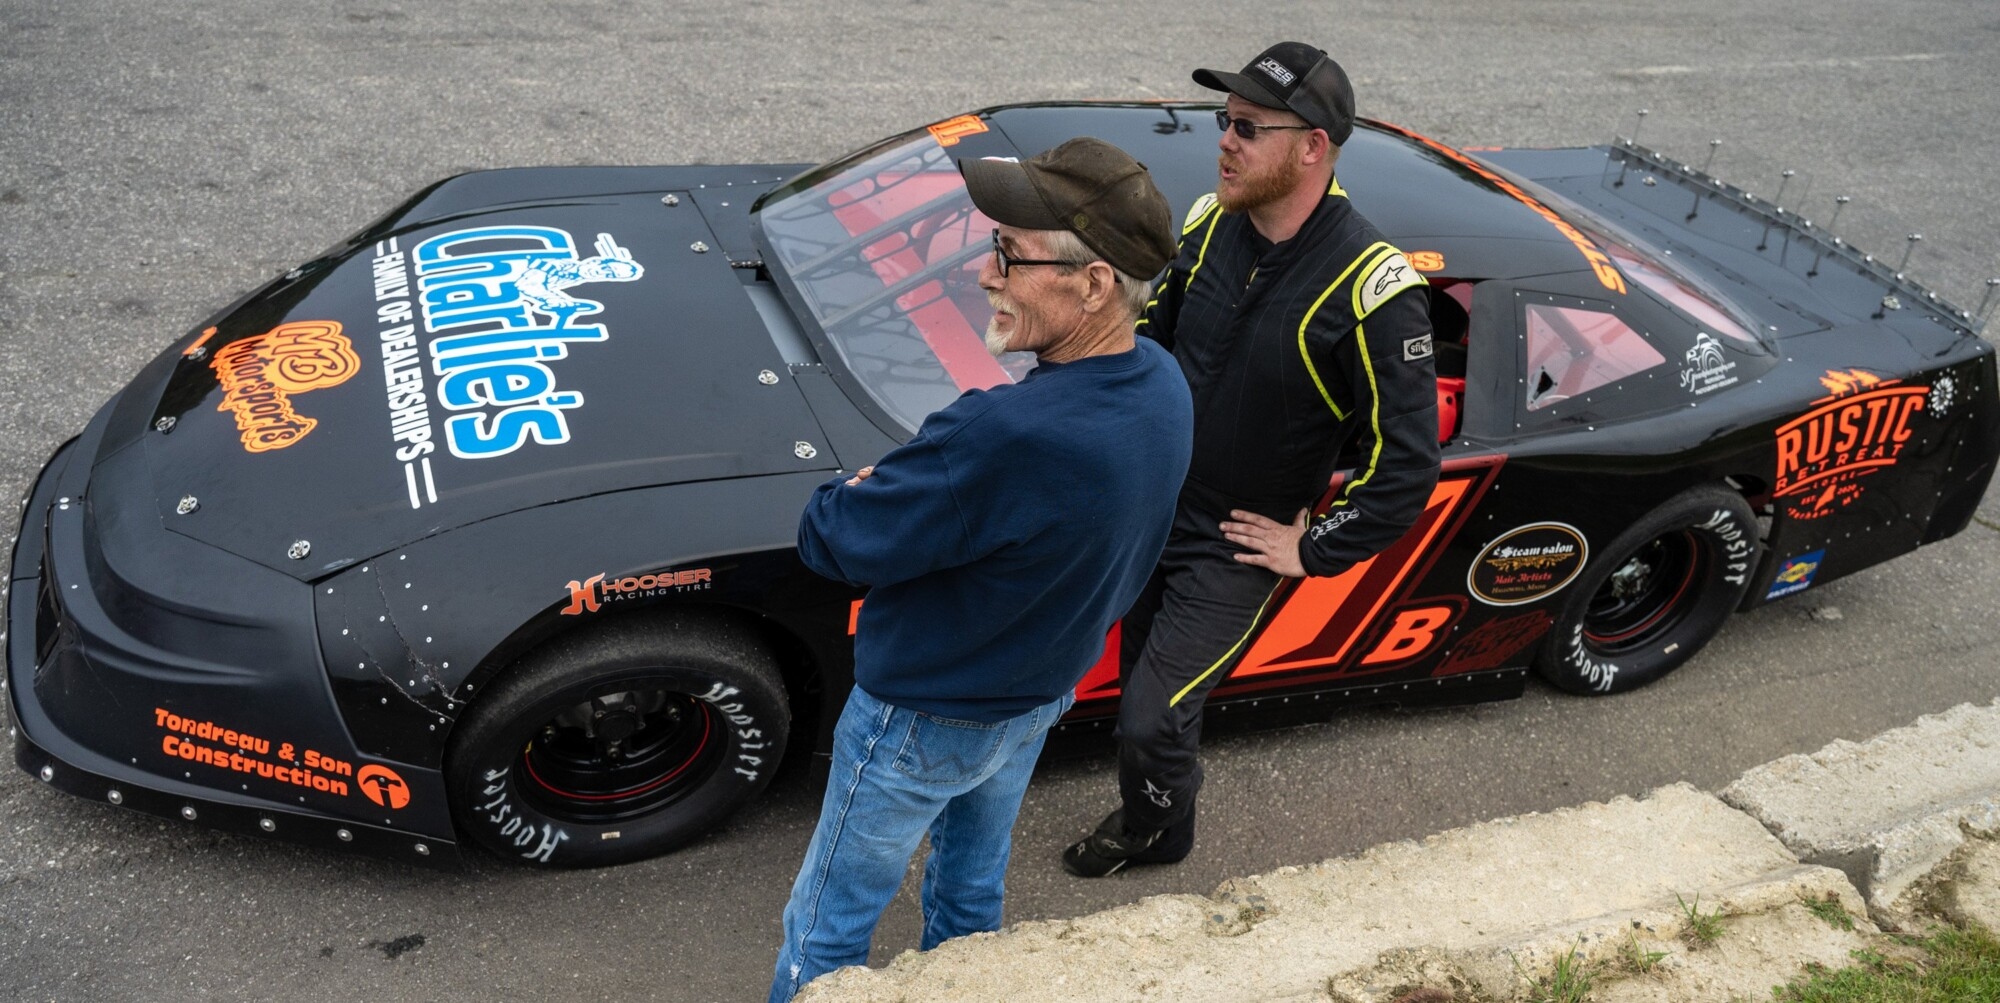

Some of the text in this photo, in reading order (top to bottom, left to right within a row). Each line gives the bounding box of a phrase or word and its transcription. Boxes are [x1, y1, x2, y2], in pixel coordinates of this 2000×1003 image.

[1260, 59, 1295, 82] JOES
[372, 251, 436, 462] FAMILY OF DEALERSHIPS
[411, 225, 609, 460] Charlie's
[222, 337, 309, 444] Motorsports
[1775, 443, 1904, 491] RETREAT
[1776, 395, 1925, 479] RUSTIC
[601, 568, 712, 595] HOOSIER
[1541, 541, 1574, 556] salon
[1694, 510, 1754, 586] Hoosier
[603, 582, 712, 603] RACING TIRE
[1360, 606, 1451, 665] B
[1564, 624, 1620, 692] Hoosier
[154, 707, 353, 778] Tondreau & Son
[162, 734, 349, 797] Construction
[694, 682, 773, 782] Hoosier
[474, 766, 570, 862] Hoosier
